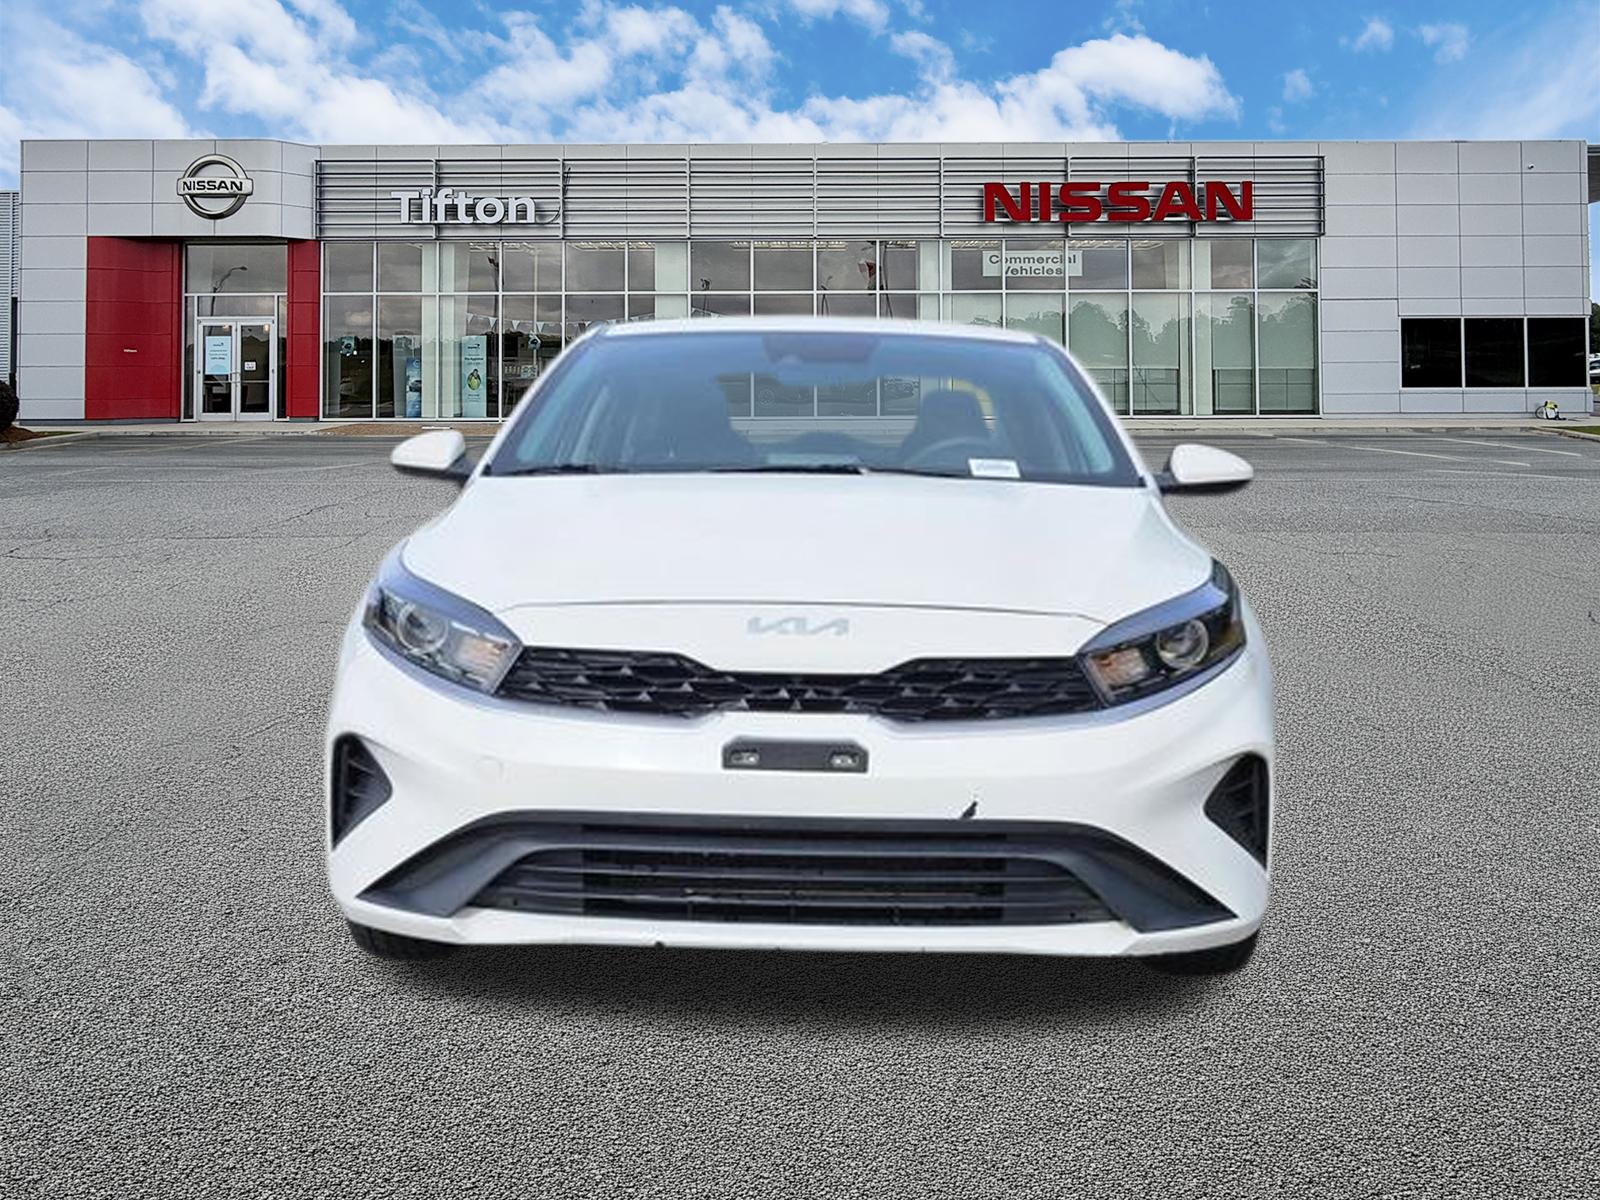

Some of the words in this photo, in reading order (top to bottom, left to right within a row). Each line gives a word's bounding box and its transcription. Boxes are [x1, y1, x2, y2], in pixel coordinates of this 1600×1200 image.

[182, 180, 243, 191] NISSAN
[390, 188, 537, 224] Tifton
[983, 181, 1253, 222] NISSAN
[747, 617, 849, 636] KIA
